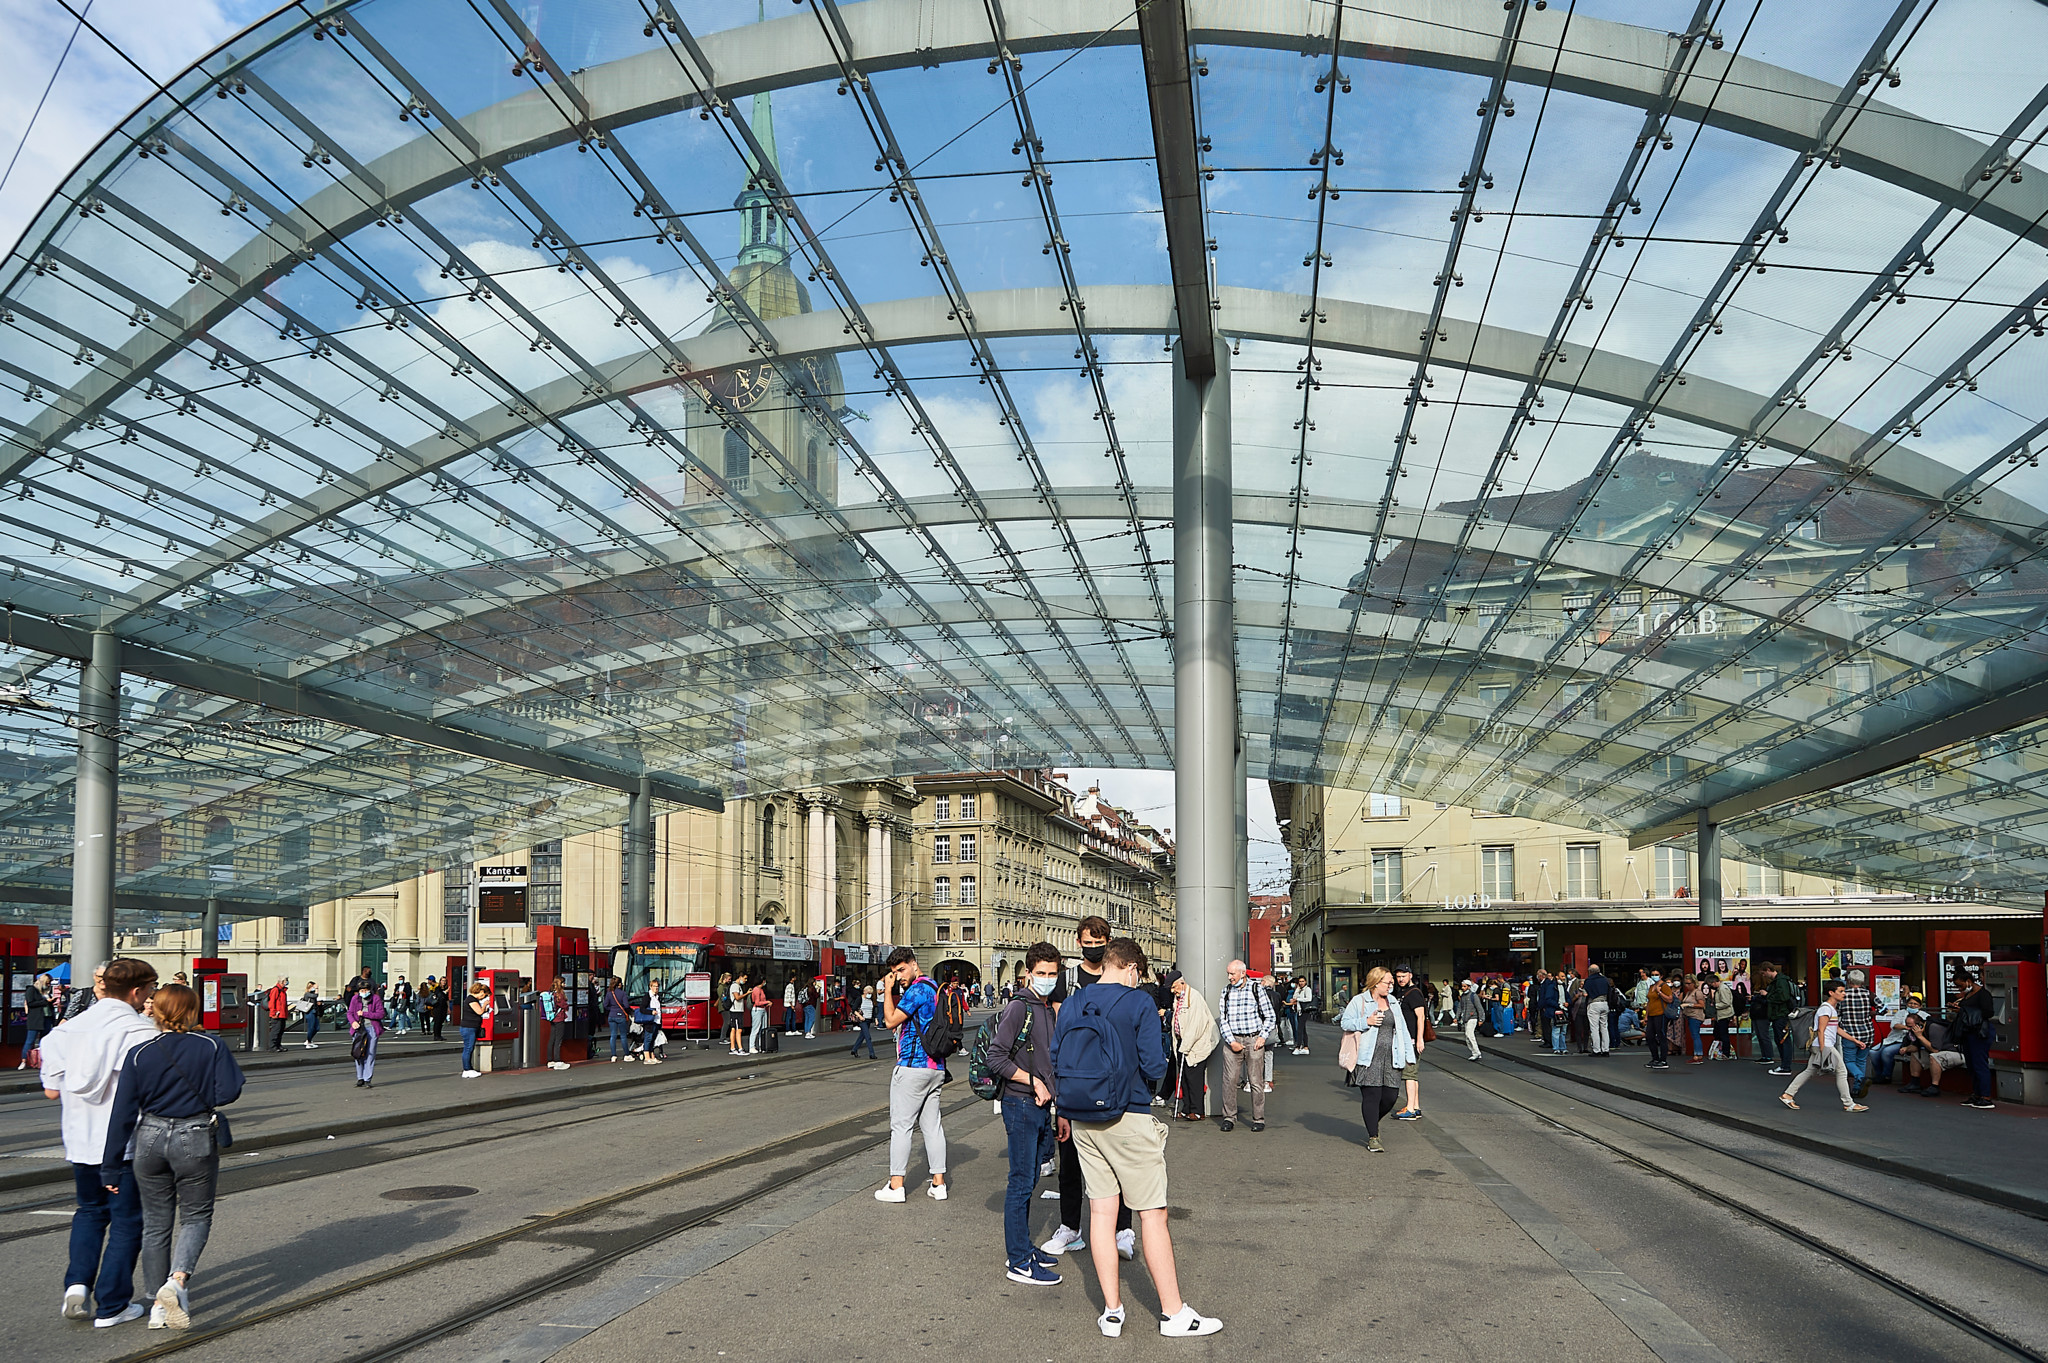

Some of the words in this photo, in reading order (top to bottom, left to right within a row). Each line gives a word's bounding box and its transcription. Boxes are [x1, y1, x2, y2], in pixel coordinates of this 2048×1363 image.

[486, 867, 511, 875] Kante
[514, 867, 520, 875] C
[1444, 894, 1491, 909] LOEB
[636, 945, 643, 954] 12
[1697, 949, 1748, 958] Deplatziert?
[1604, 951, 1627, 959] LOEB
[1986, 970, 2004, 978] Tickets
